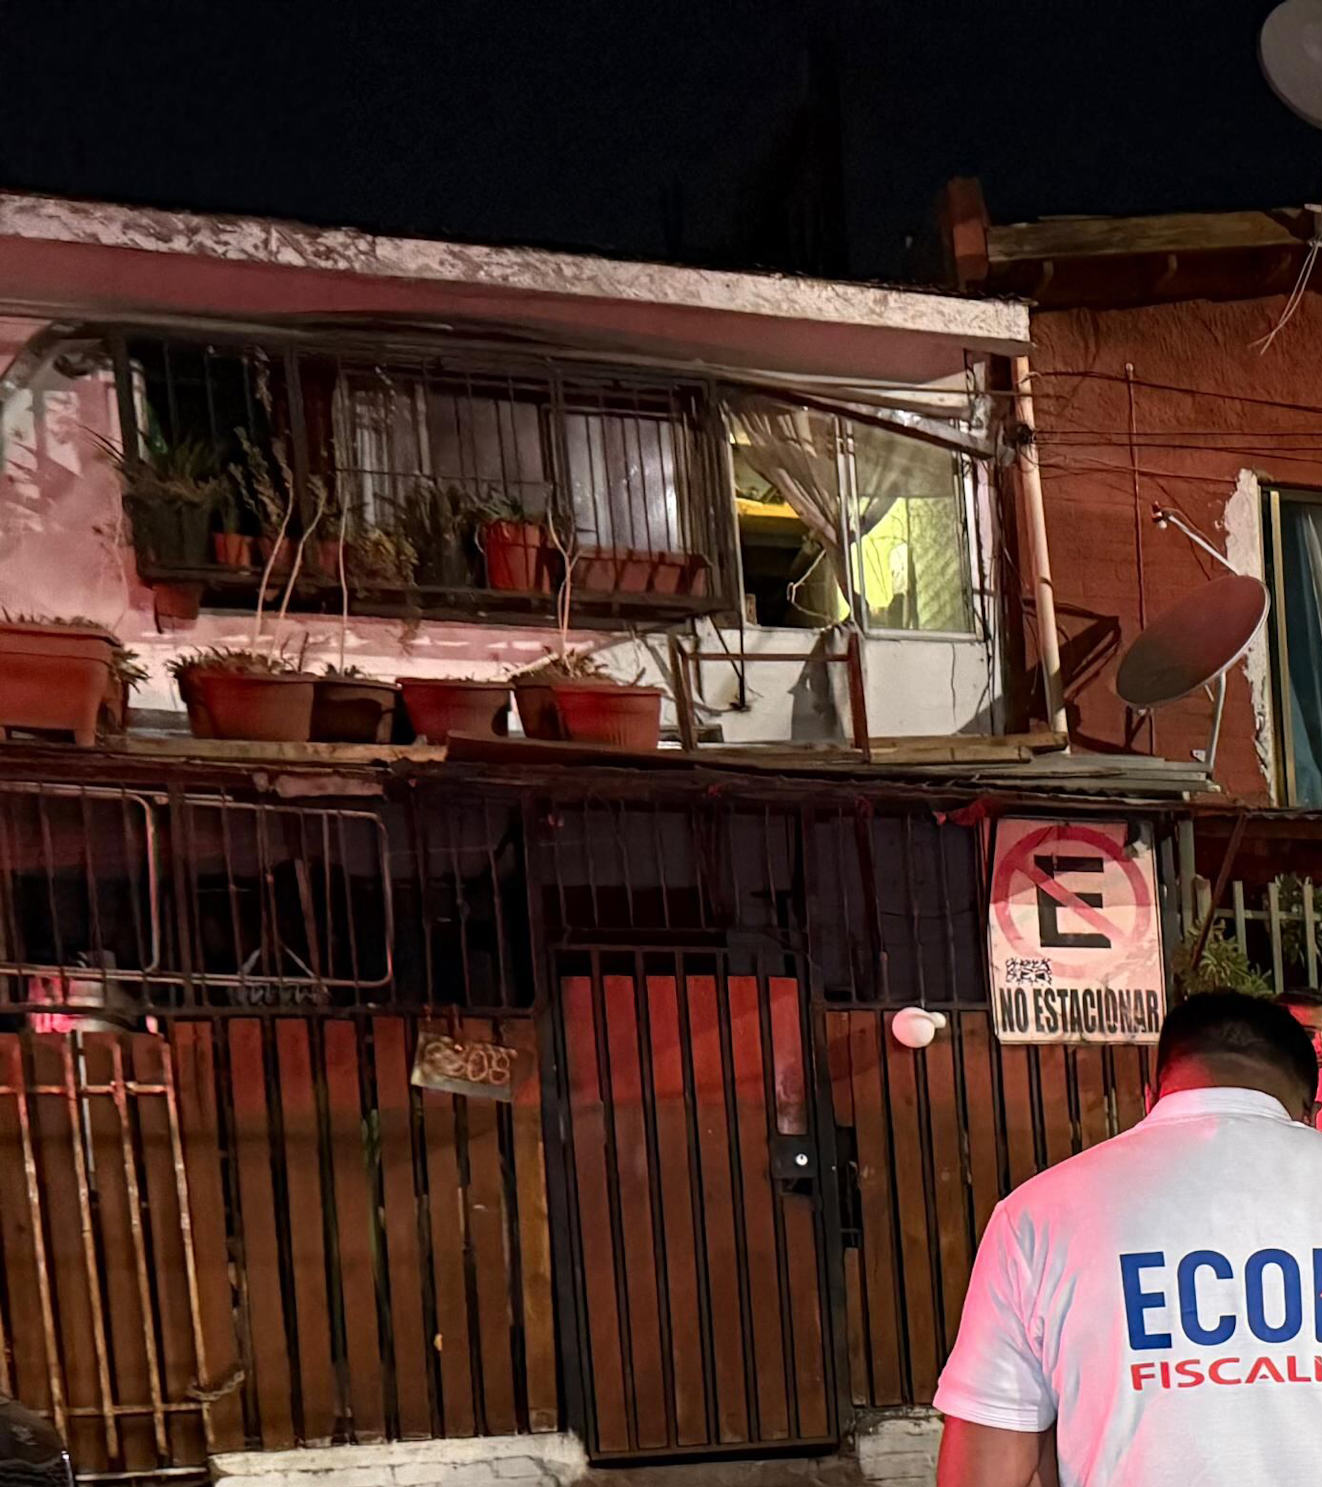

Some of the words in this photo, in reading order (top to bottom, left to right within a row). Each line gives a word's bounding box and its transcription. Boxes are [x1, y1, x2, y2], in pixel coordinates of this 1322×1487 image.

[1034, 855, 1111, 948] E
[1000, 988, 1028, 1033] NO
[1033, 988, 1160, 1034] ESTACIONAR
